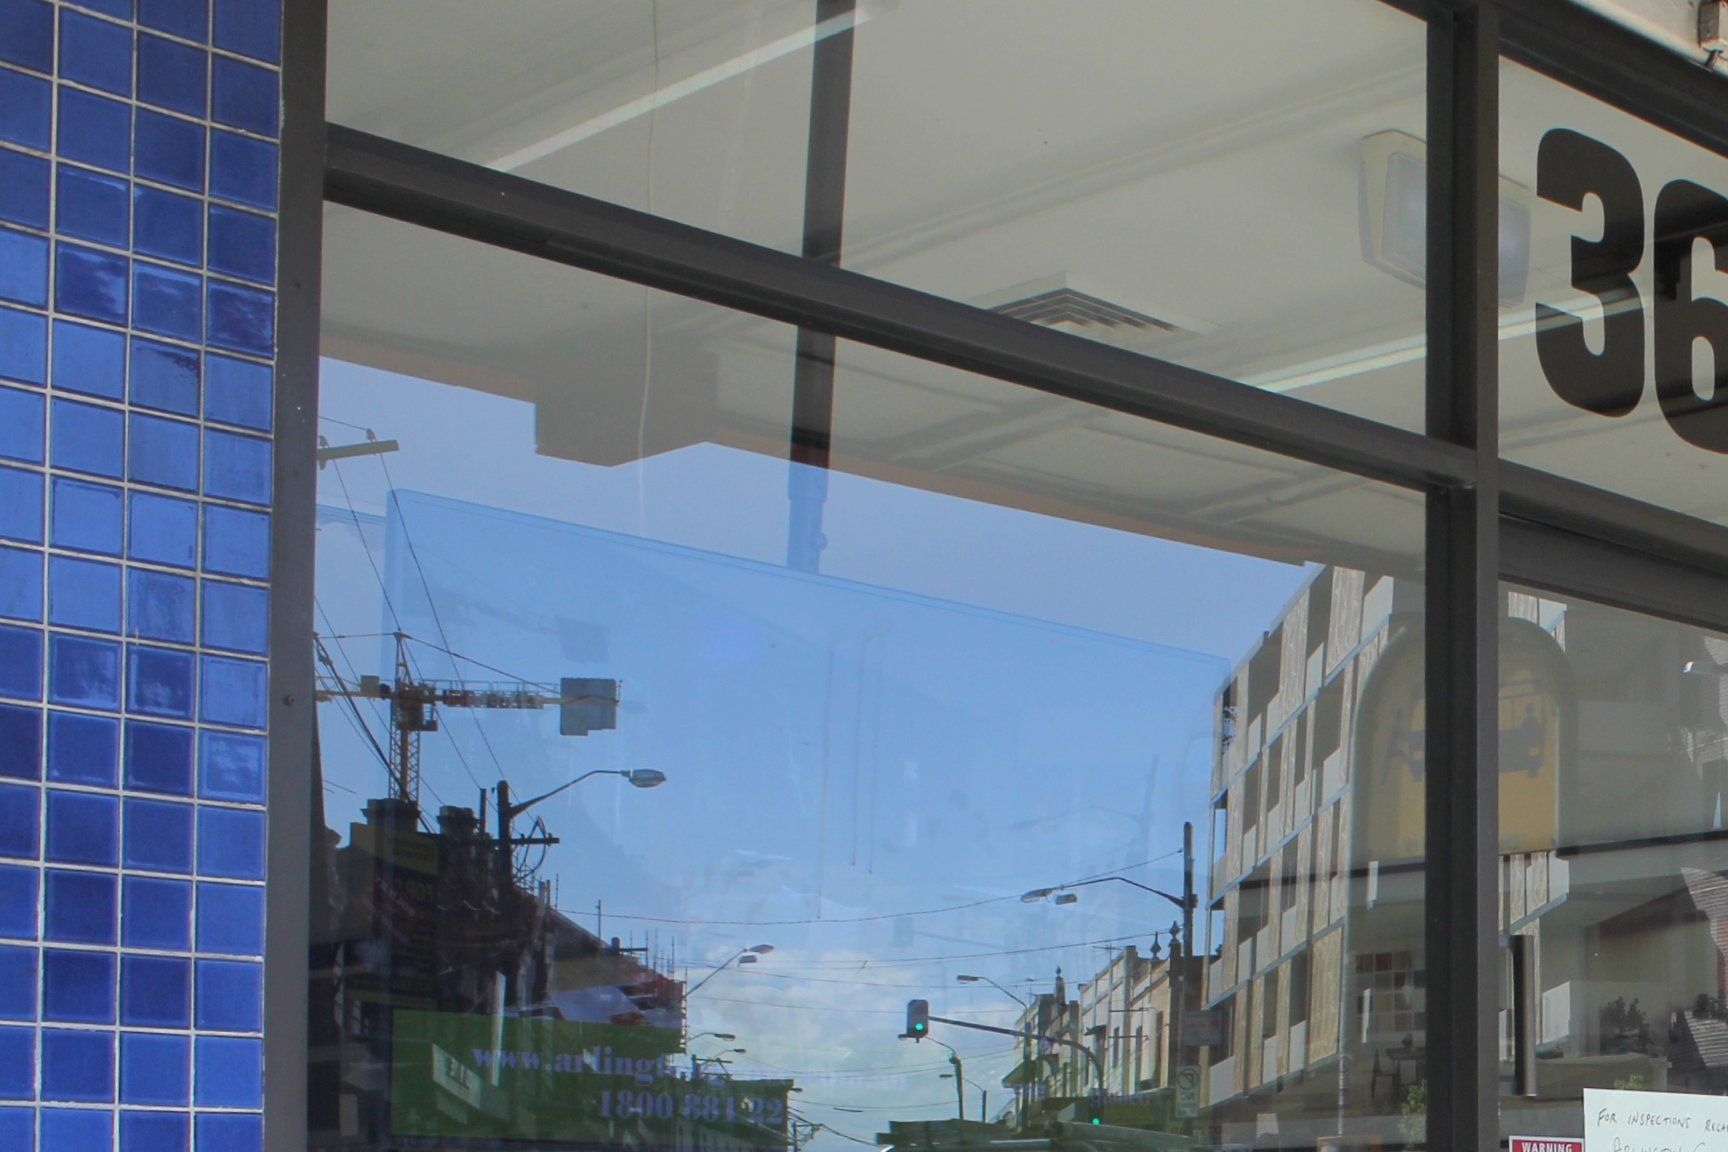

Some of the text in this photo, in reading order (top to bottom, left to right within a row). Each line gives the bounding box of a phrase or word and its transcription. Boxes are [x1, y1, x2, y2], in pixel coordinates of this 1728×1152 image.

[601, 1090, 674, 1119] 1800
[681, 1093, 737, 1122] 881
[1597, 1107, 1617, 1126] FOR
[1628, 1111, 1692, 1129] INSPECTIONS
